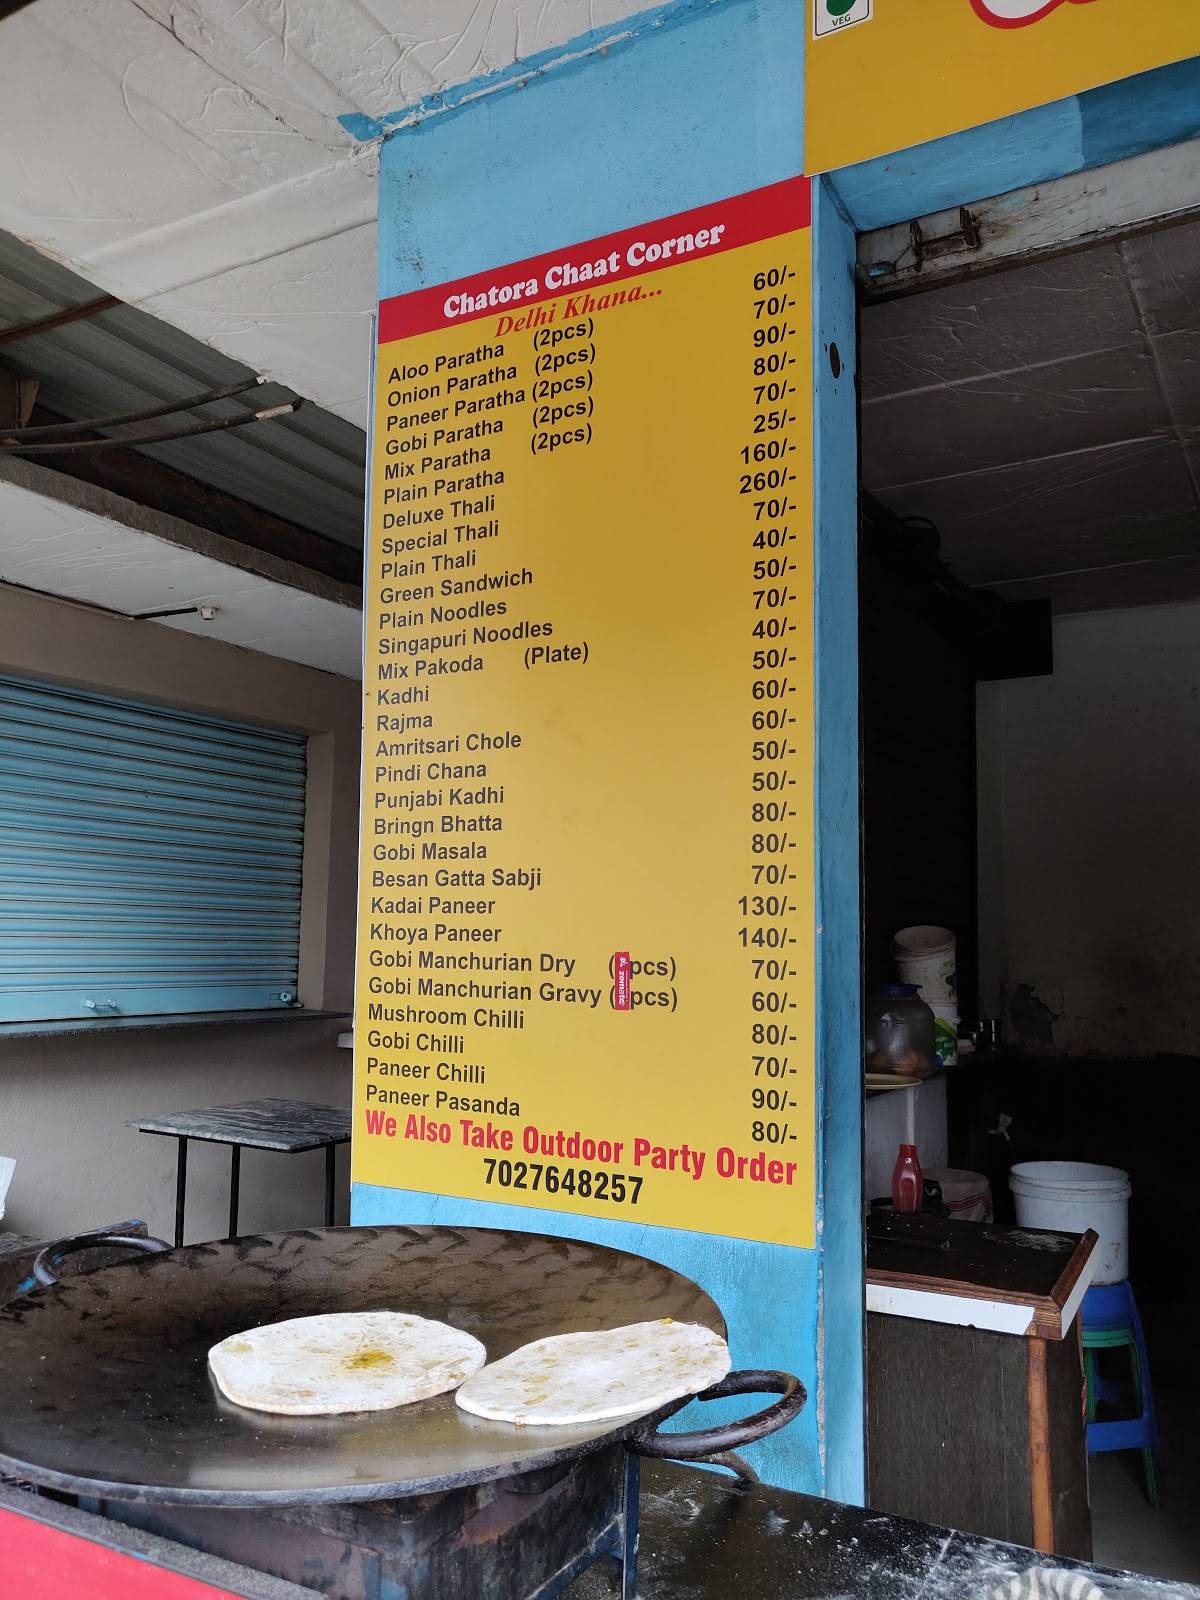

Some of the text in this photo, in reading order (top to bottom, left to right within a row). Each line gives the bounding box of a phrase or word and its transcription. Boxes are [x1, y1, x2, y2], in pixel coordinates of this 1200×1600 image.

[831, 14, 851, 27] VEG
[444, 225, 724, 317] Chatora Chaat Corner
[388, 265, 795, 384] Aloo Paratha (2pcs) 60/-
[496, 287, 662, 336] Delhi Khana...
[387, 322, 795, 431] Paneer Paratha (2pcs) 90/-
[388, 294, 795, 406] Onion Paratha (2pcs) 70/-
[385, 380, 795, 480] Mix Paratha (2pcs) 70/-
[386, 351, 796, 455] Gobi Paratha (2pcs) 80/-
[384, 409, 796, 504] Plain Paratha 25/-
[384, 438, 796, 529] Deluxe Thali 160/-
[382, 467, 796, 556] Special Thali 260/-
[382, 497, 796, 579] Plain Thali 70/-
[380, 557, 796, 629] Plain Noodles 50/-
[381, 527, 796, 603] Green Sandwich 40/-
[379, 587, 796, 655] Singapuri Noodles 70/-
[379, 617, 796, 680] Mix Pakoda (Plate) 40/-
[378, 648, 796, 705] Kadhi 50/-
[376, 709, 796, 756] Amritsari Chole 60/-
[378, 678, 796, 733] Rajma 60/-
[376, 740, 796, 782] Pindi Chana 50/-
[376, 771, 796, 811] Punjabi Kadhi 50/-
[374, 833, 796, 860] Gobi Masala 80/-
[375, 802, 796, 837] Bringn Bhatta 80/-
[373, 864, 796, 890] Besan Gatta Sabji 70/-
[372, 896, 796, 916] Kadai Paneer 130/-
[371, 924, 796, 948] Khoya Paneer 140/-
[370, 950, 796, 981] Gobi Manchurian Dry (pcs) 70/-
[369, 977, 410, 994] Gobi
[419, 979, 531, 1000] Manchurian
[540, 983, 601, 1008] Gravy
[610, 986, 677, 1012] (pcs)
[752, 992, 796, 1013] 60/-
[369, 1004, 796, 1045] Mushroom Chilli 80/-
[368, 1031, 796, 1078] Gobi Chilli 70/-
[368, 1058, 796, 1111] Paneer Chilli 90/-
[367, 1085, 796, 1144] Paneer Pasanda 80/-
[366, 1111, 797, 1184] We Also Take Outdoor Party Order
[484, 1158, 643, 1204] 7027648257
